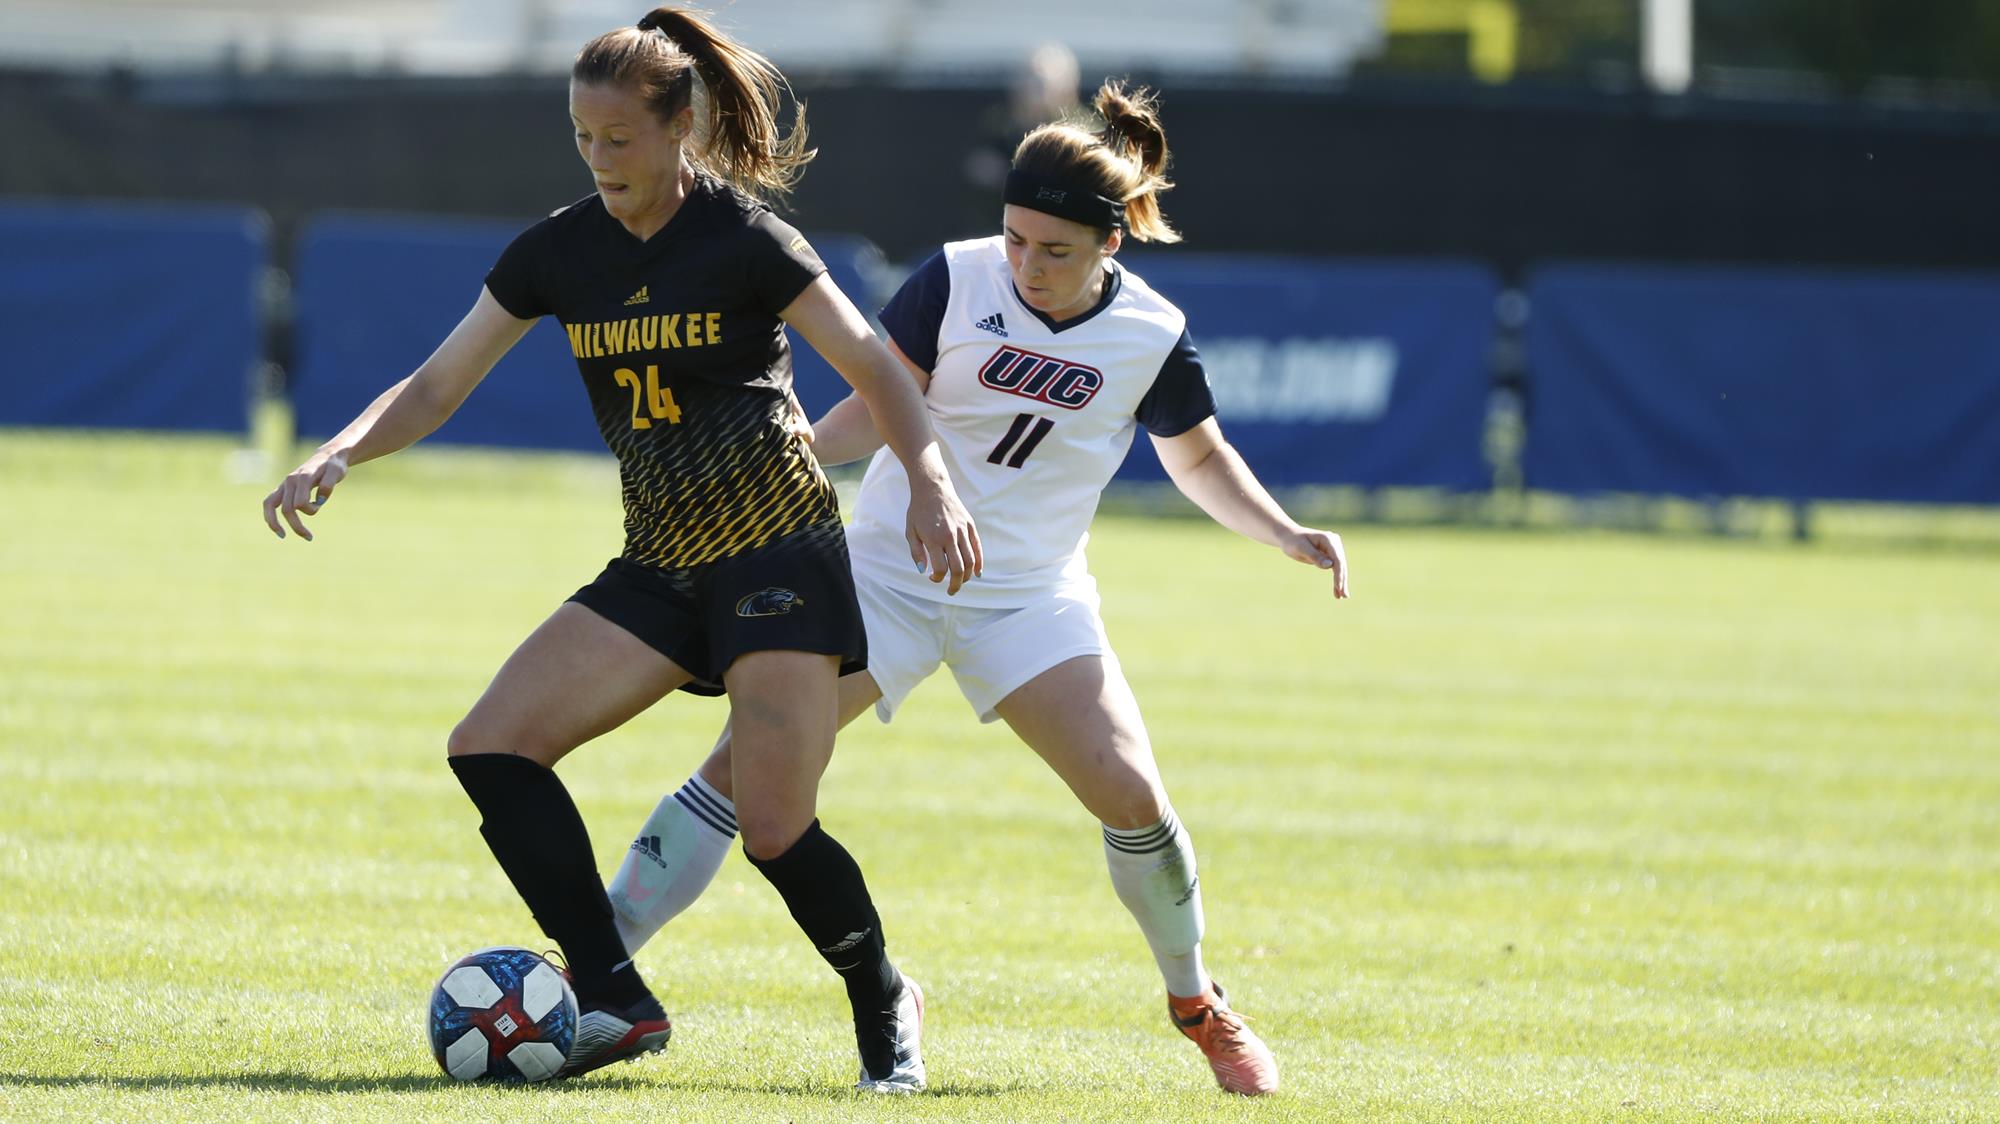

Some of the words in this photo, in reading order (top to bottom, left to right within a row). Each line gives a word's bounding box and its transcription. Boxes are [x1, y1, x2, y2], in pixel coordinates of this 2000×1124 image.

[566, 312, 722, 359] MILWAUKEE
[975, 321, 1009, 338] adidas
[613, 364, 683, 431] 24
[980, 347, 1102, 408] UIC
[986, 412, 1056, 469] 11
